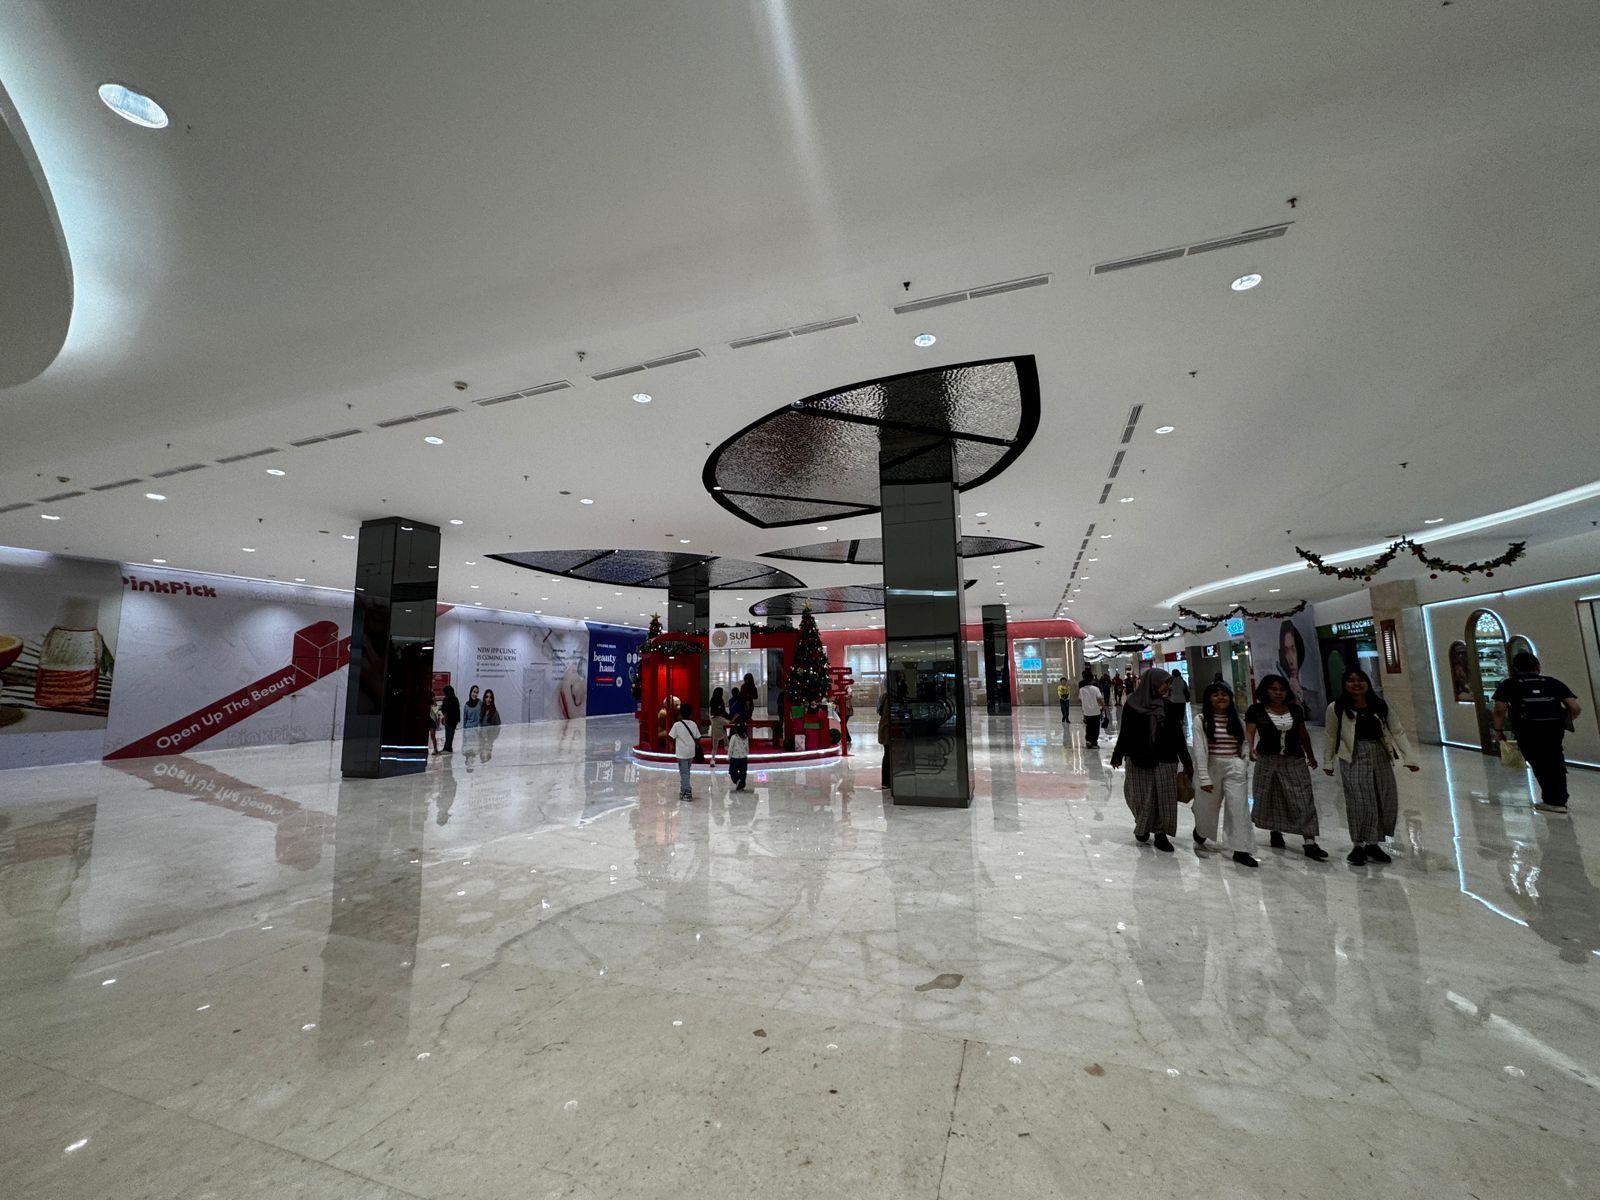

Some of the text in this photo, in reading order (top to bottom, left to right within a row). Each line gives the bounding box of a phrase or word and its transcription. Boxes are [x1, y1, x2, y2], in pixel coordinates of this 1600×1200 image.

[1337, 623, 1351, 632] YVES
[729, 632, 749, 640] SUN
[593, 650, 617, 664] beauty
[156, 672, 297, 749] Open Up The Beauty
